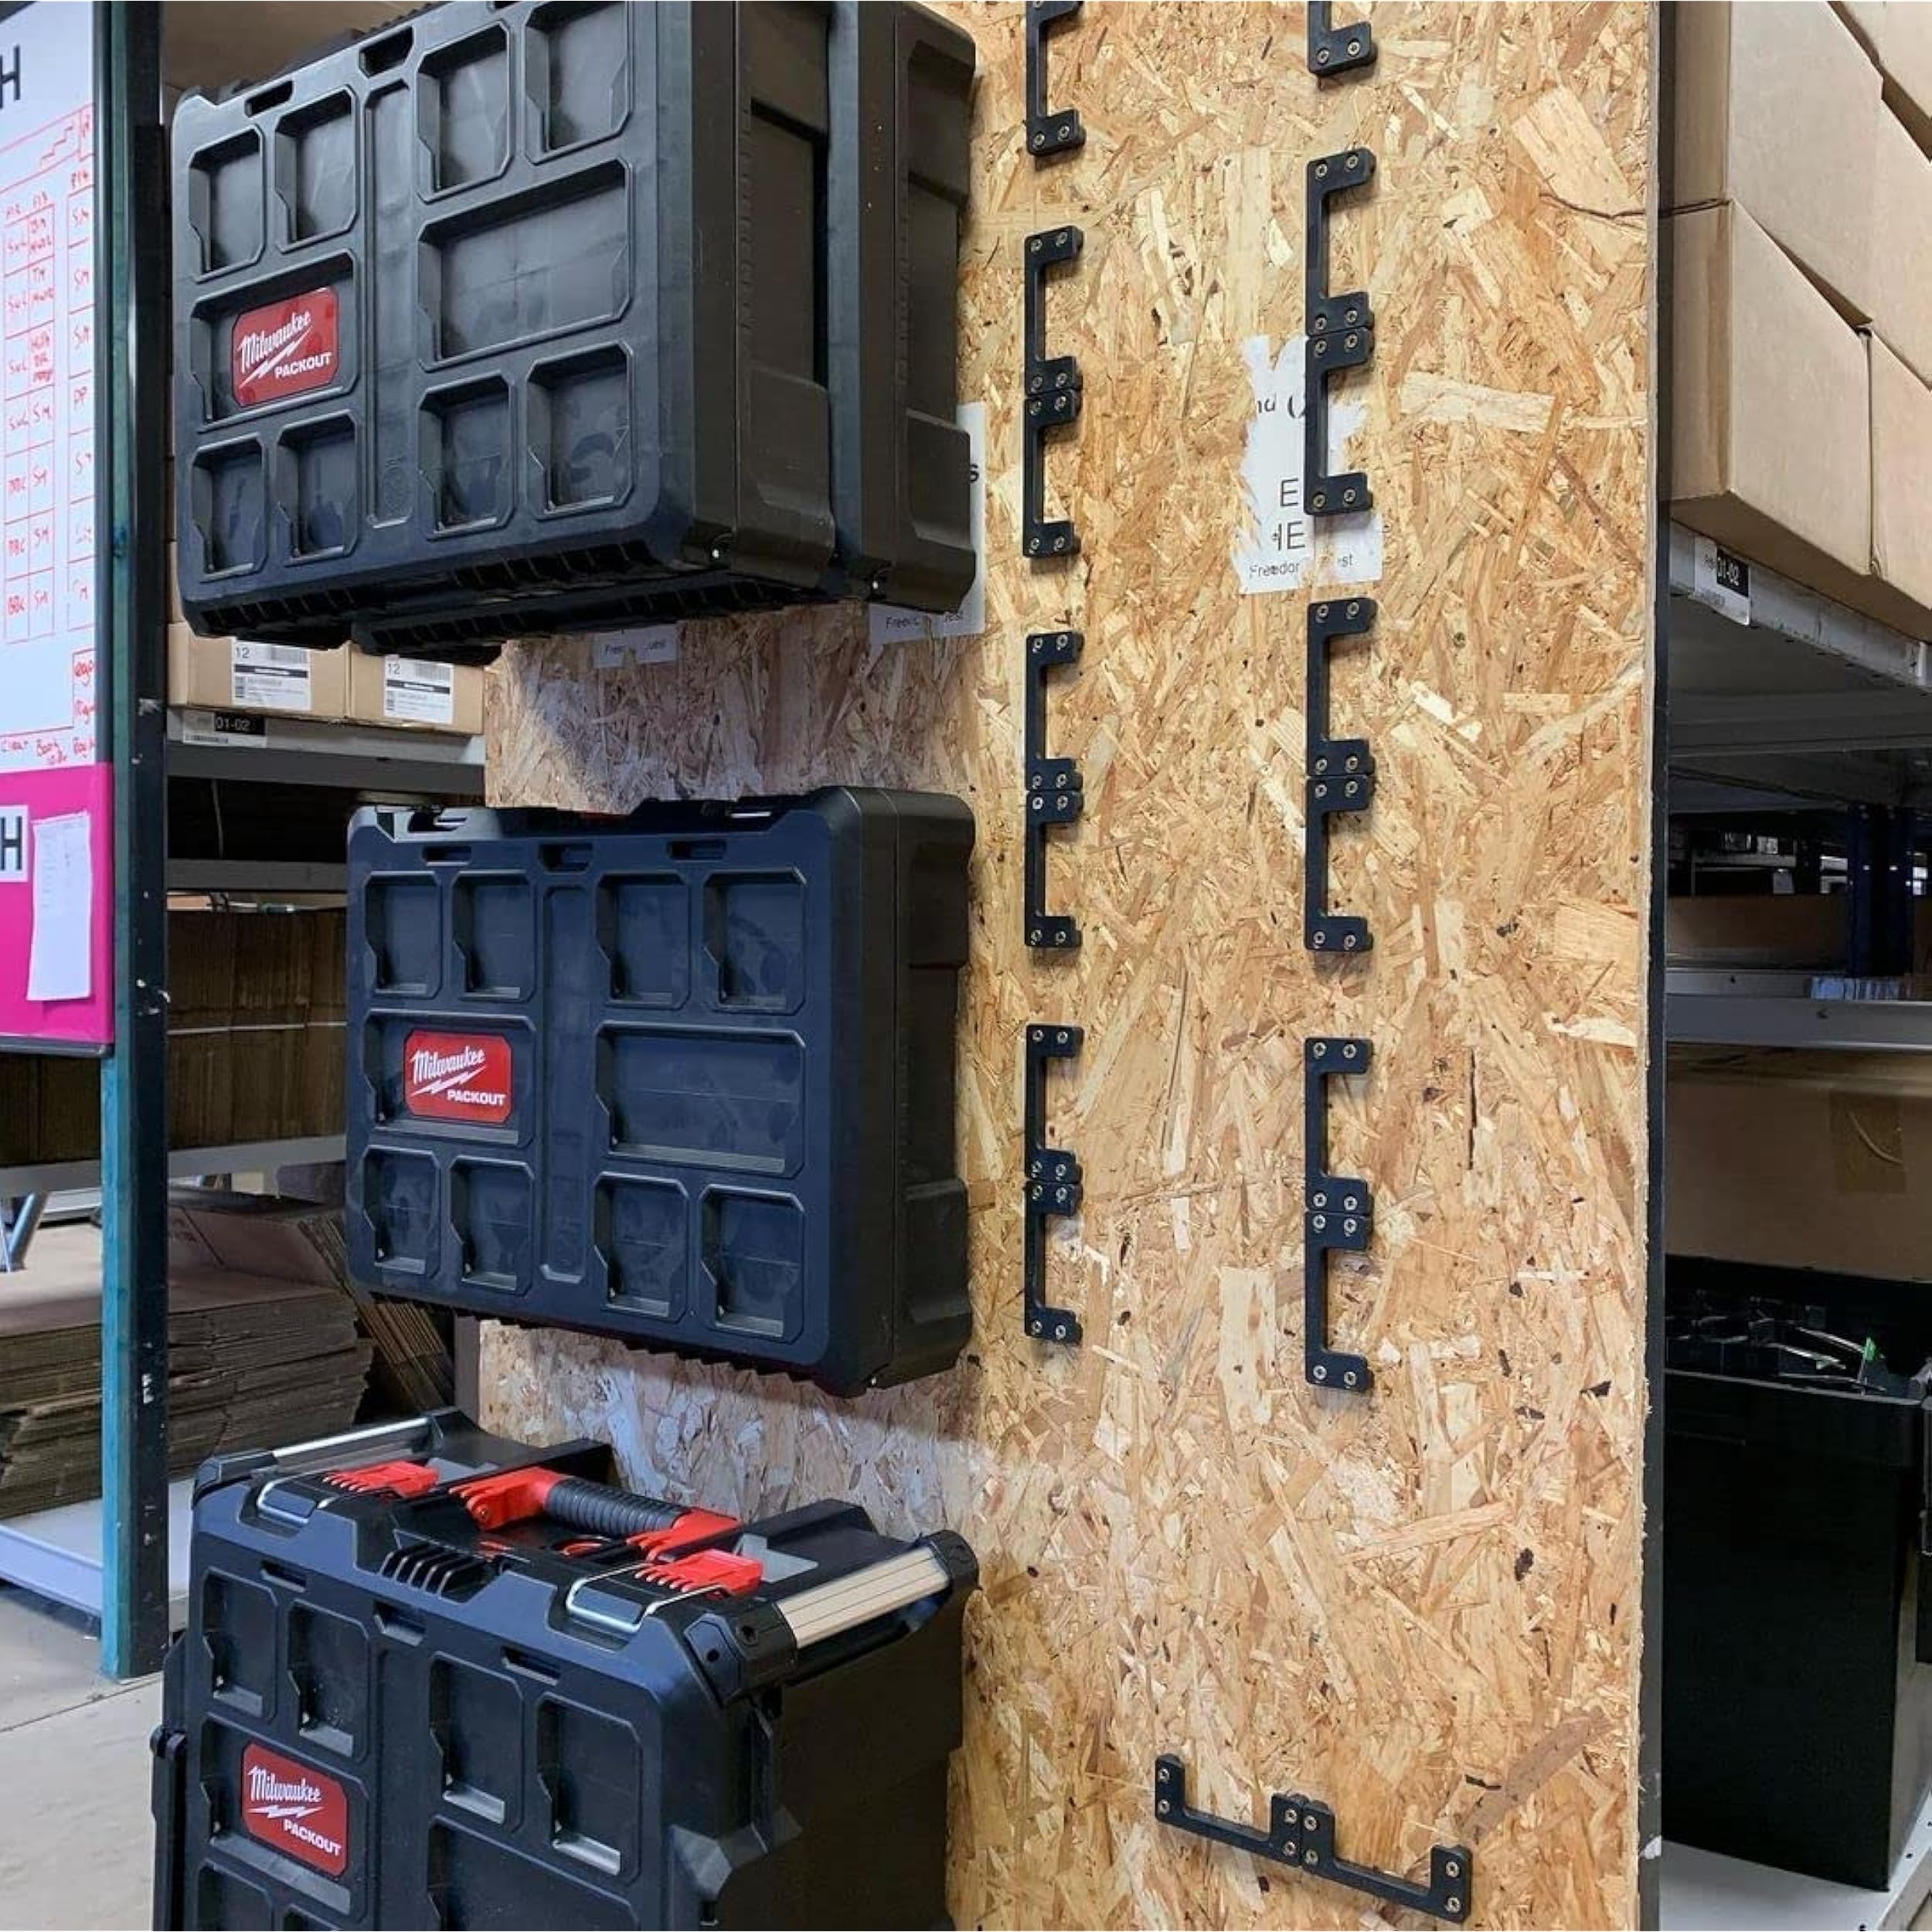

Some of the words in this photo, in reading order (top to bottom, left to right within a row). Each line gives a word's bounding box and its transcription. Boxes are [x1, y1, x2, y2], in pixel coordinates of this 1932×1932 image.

[237, 311, 311, 374] Milwaukee
[274, 352, 332, 379] PACKOUT
[236, 647, 250, 659] 12
[388, 663, 400, 675] 12
[410, 1046, 485, 1085] Milwaukee
[447, 1090, 506, 1107] PACKOUT
[247, 1765, 322, 1802] Milwaukee
[283, 1819, 342, 1856] PACKOUT
